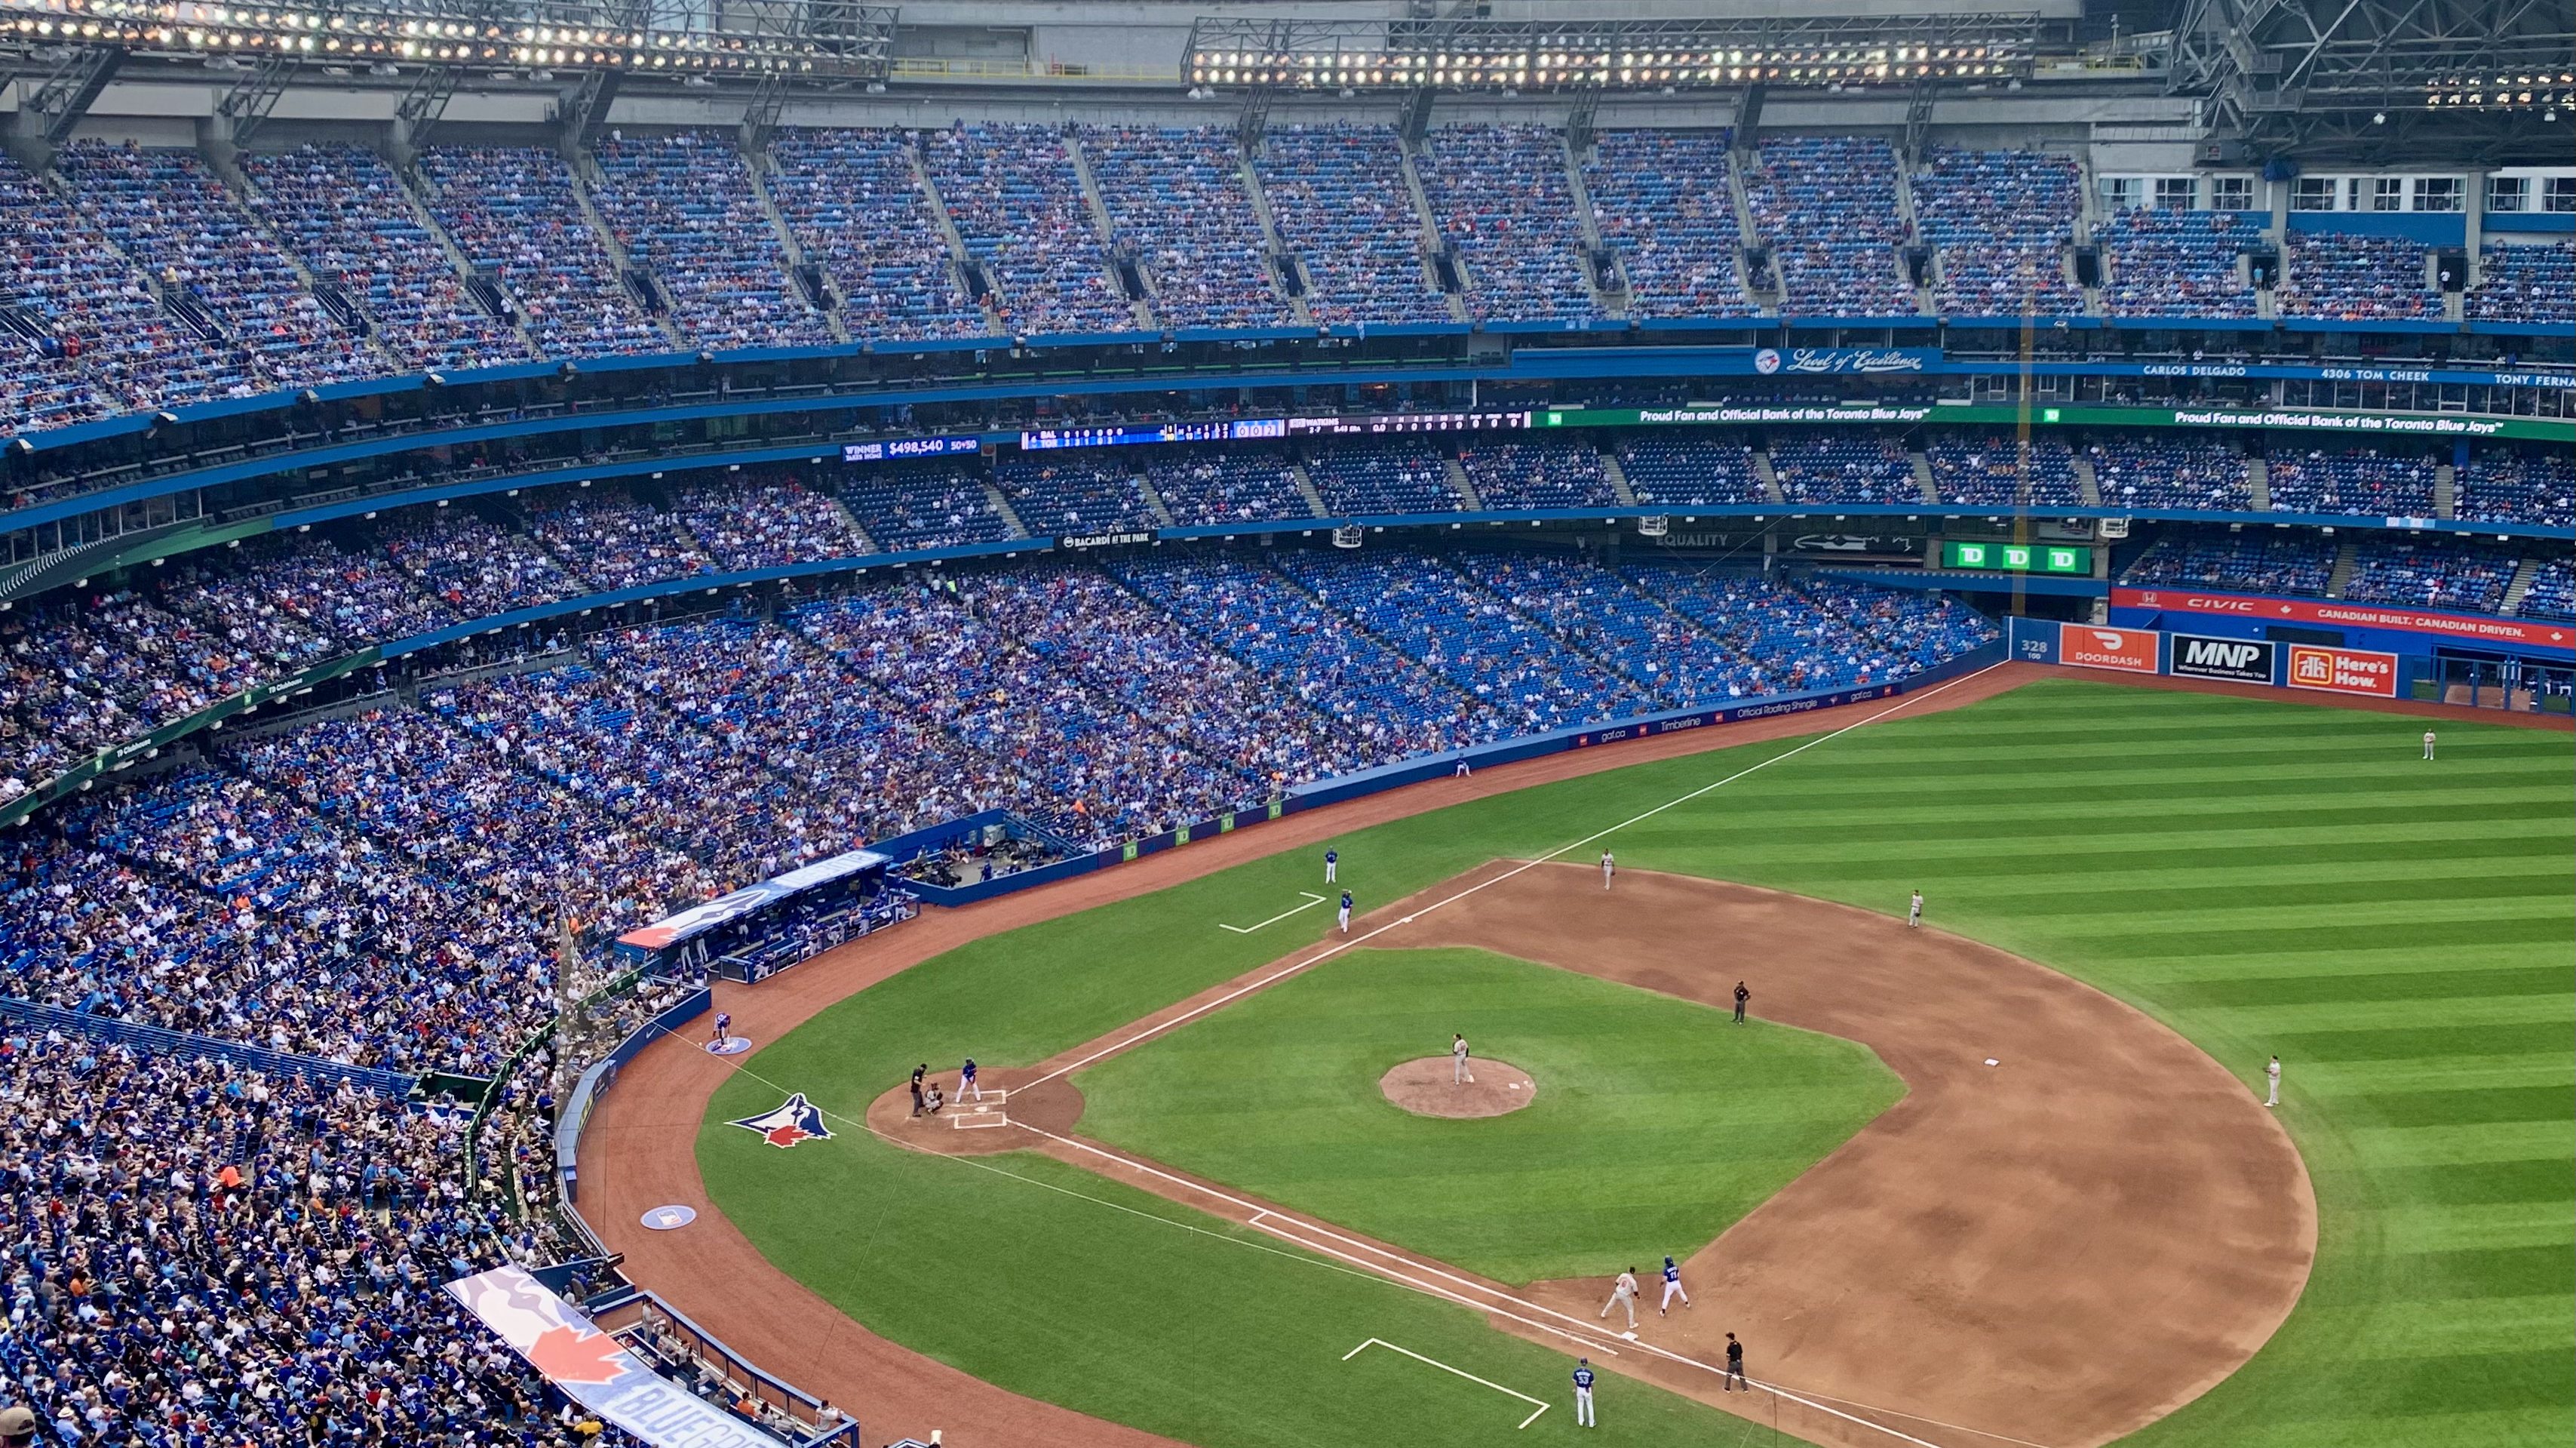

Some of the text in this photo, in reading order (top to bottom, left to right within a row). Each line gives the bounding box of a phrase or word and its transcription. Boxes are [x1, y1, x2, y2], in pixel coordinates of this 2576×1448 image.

[1786, 348, 1923, 372] Level of Excellence
[2143, 365, 2246, 376] CARLOS DELGADO
[2321, 368, 2430, 382] 4306 TOM CHEEK
[2495, 374, 2530, 385] TONY
[1306, 418, 1339, 426] WATKINS
[1640, 410, 1673, 422] Proud
[1675, 410, 1695, 421] Fan
[1696, 410, 1719, 421] and
[1720, 409, 1761, 421] Official
[1762, 409, 1790, 420] Bank
[1792, 408, 1804, 420] of
[1805, 408, 1824, 420] the
[1826, 408, 1869, 420] Toronto
[1871, 408, 1896, 420] Blue
[2175, 412, 2212, 423] Proud
[2212, 413, 2236, 424] Fan
[2237, 413, 2262, 424] and
[2264, 413, 2310, 426] Official
[2311, 415, 2343, 427] Bank
[2344, 416, 2359, 427] of
[2360, 417, 2382, 429] the
[2384, 418, 2434, 431] Toronto
[2436, 420, 2464, 432] Blue
[845, 444, 882, 454] WINNER
[889, 439, 944, 456] $498,540
[1119, 534, 1131, 543] THE
[1132, 533, 1149, 543] PARK
[1656, 533, 1729, 547] EQUALITY
[1960, 547, 2074, 567] TD TD TD
[2188, 598, 2255, 610] CIVIC
[2318, 609, 2378, 623] CANADIAN
[2415, 617, 2476, 632] CANADIAN
[2479, 624, 2525, 638] DRIVEN.
[2022, 640, 2048, 653] 328
[2075, 652, 2142, 666] DOORDASH
[2185, 641, 2260, 669] MNP
[2209, 668, 2235, 676] Business
[2335, 671, 2377, 688] How.
[1737, 706, 1763, 718] Official
[1764, 702, 1791, 715] Roofing
[1792, 699, 1818, 711] Shingle
[1661, 716, 1701, 732] Timberline
[1270, 805, 1281, 816] TD
[1223, 819, 1233, 829] TD
[1177, 831, 1188, 842] TD
[1125, 845, 1135, 858] TD
